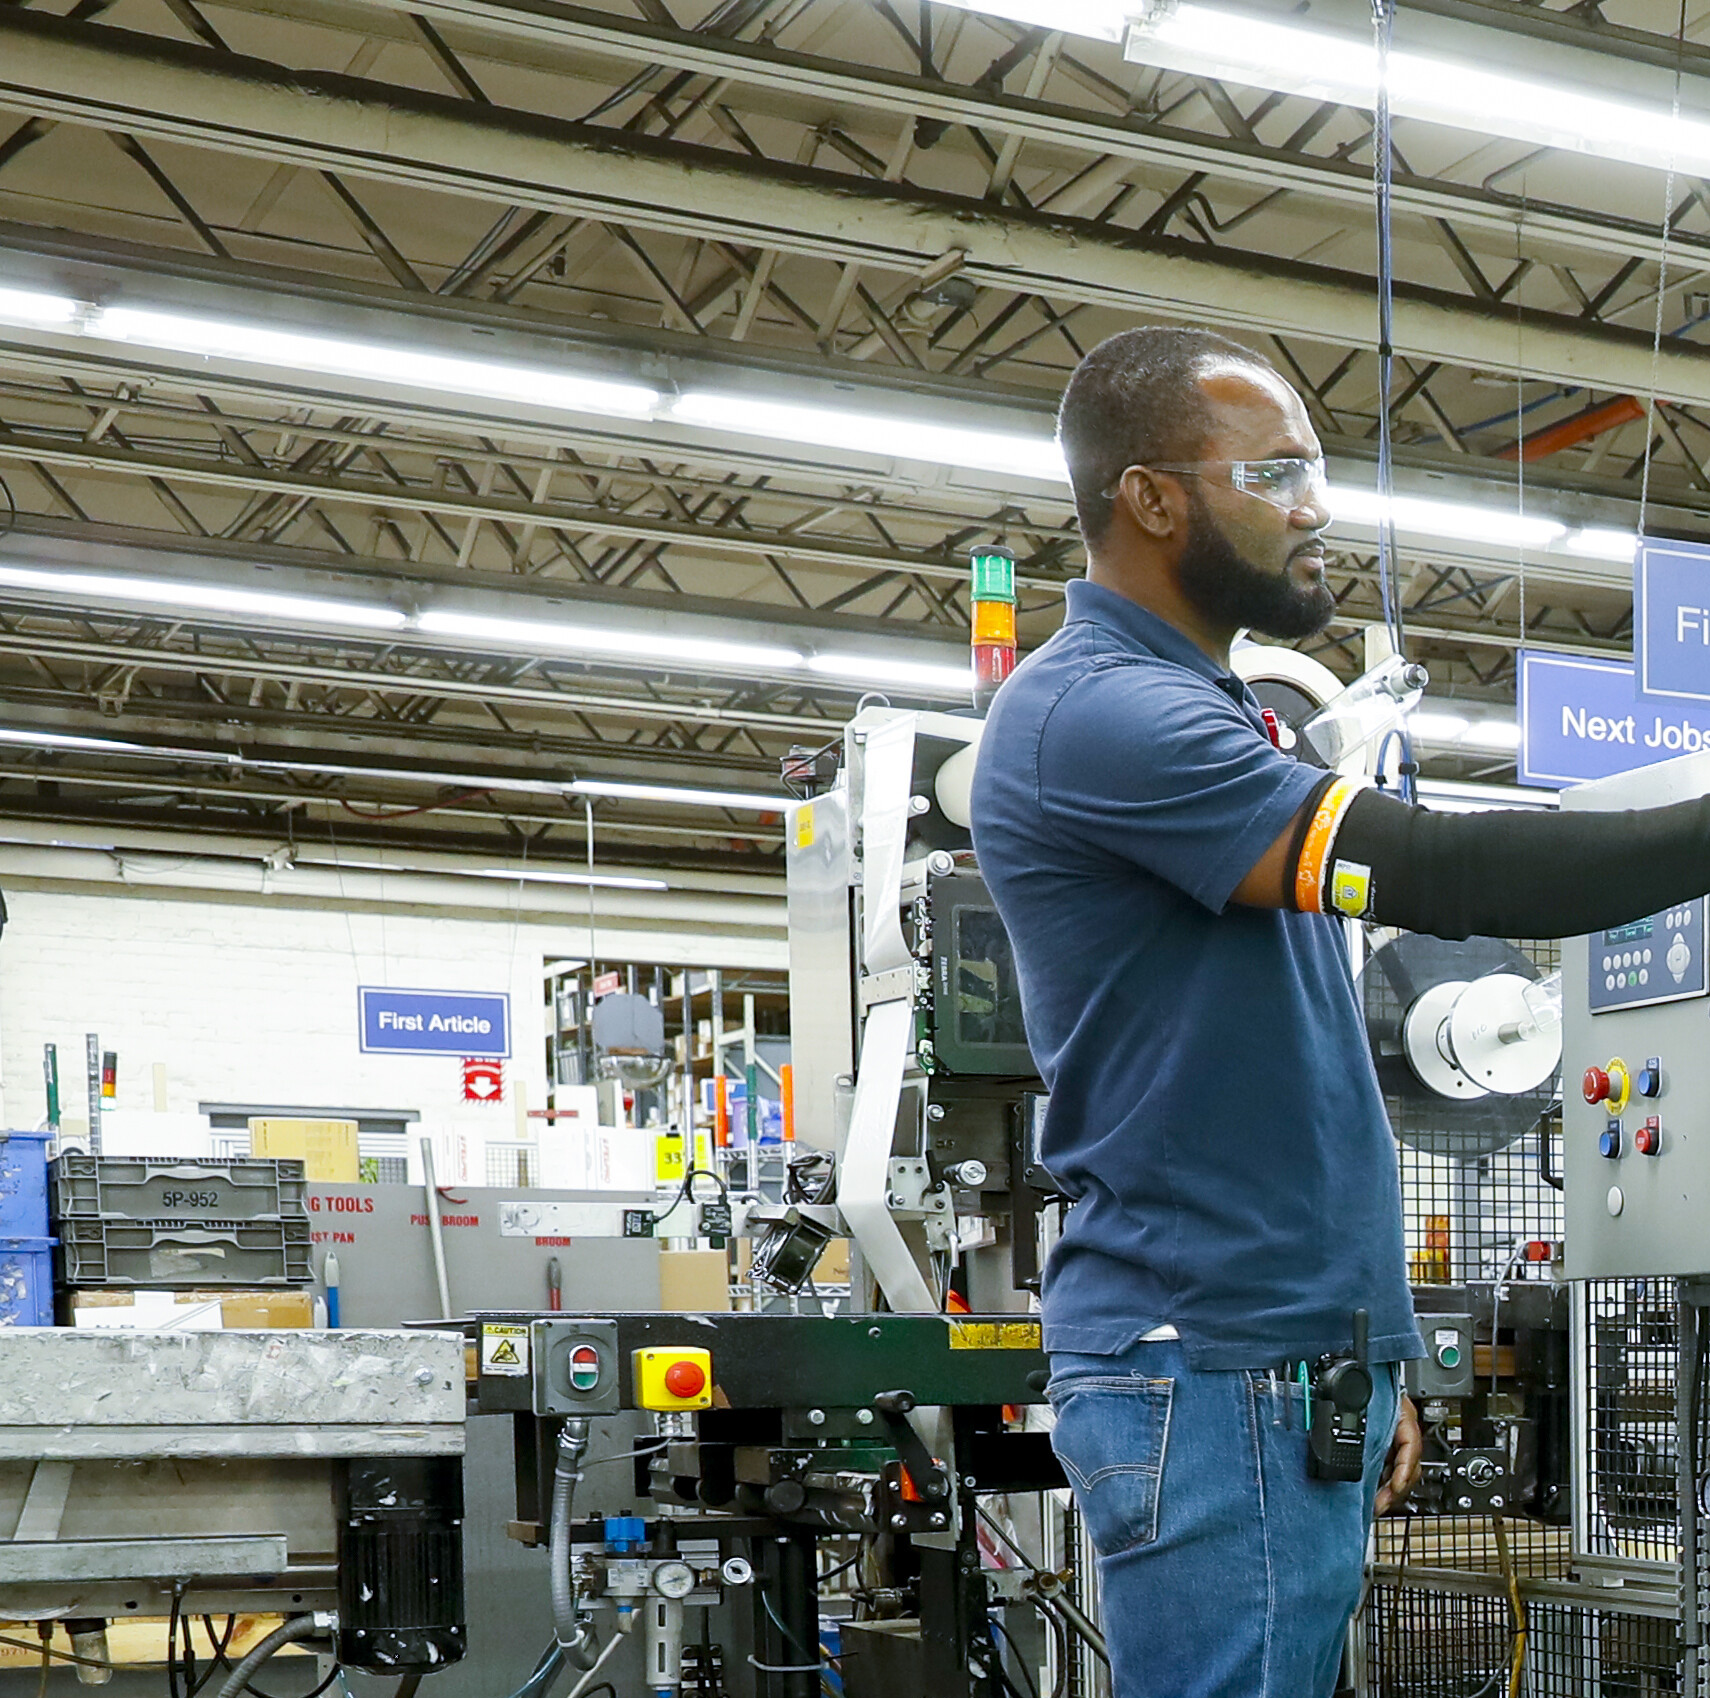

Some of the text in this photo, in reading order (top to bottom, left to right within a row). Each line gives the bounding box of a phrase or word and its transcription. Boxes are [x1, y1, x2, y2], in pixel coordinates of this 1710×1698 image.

[1562, 705, 1636, 744] Next
[378, 1011, 492, 1034] First Article
[162, 1190, 219, 1208] 5P-952
[325, 1196, 374, 1213] TOOLS
[442, 1216, 480, 1227] BROOM
[333, 1233, 355, 1244] PAN
[535, 1236, 571, 1247] BROOM
[494, 1326, 527, 1335] CAUTION
